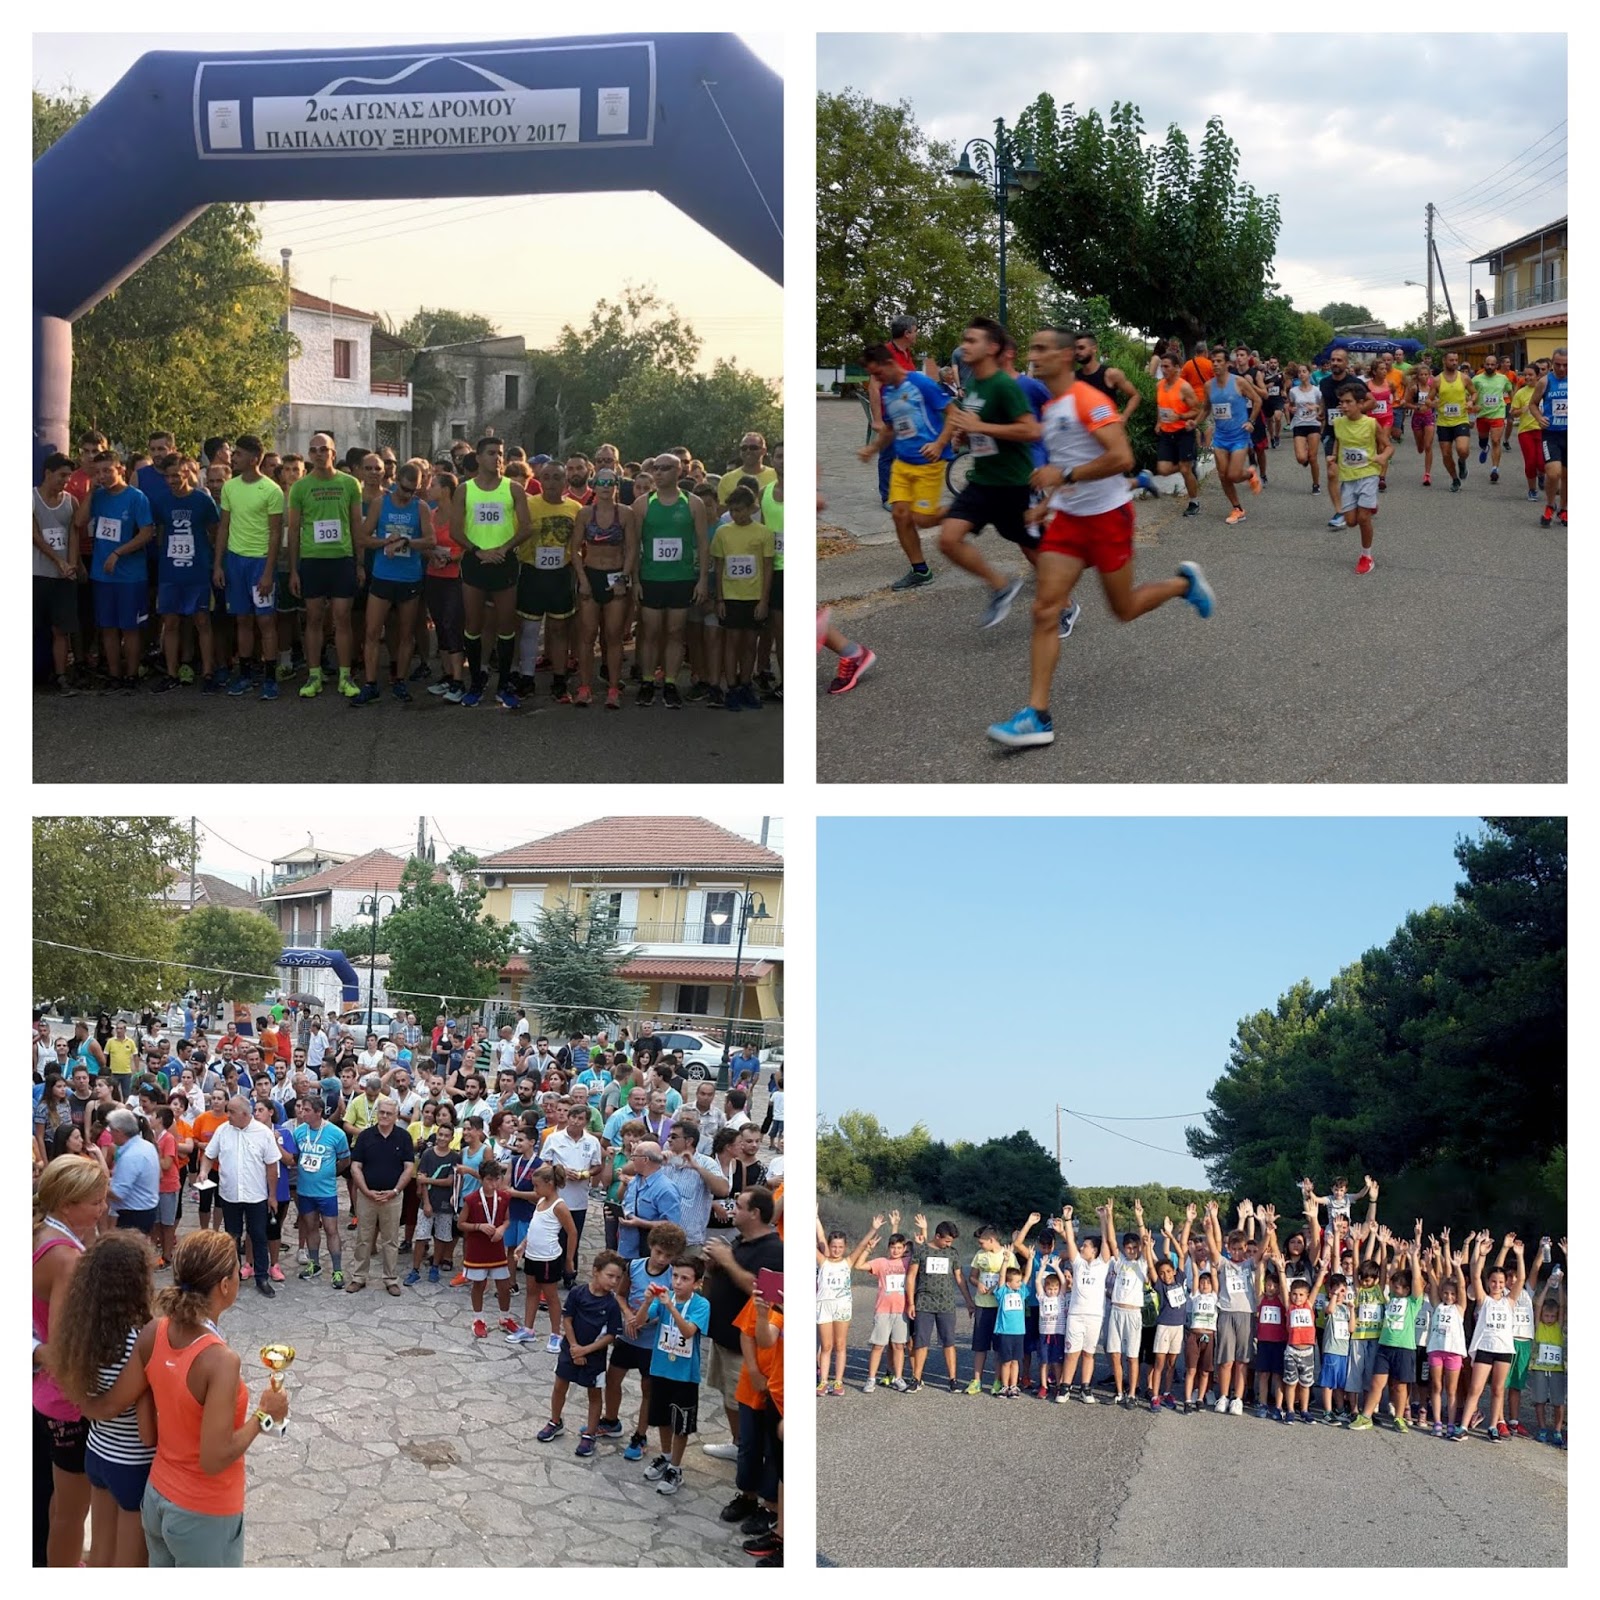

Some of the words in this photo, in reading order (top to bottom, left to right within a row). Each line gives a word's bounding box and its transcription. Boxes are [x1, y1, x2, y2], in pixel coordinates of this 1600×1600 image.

[305, 98, 338, 125] 2ος
[341, 98, 424, 122] ΑΓΩΝΑΣ
[428, 97, 517, 119] ΔΡΟΜΟΥ
[266, 129, 387, 148] ΠΑΠΑΔΑΤΟΥ
[392, 125, 521, 147] ΞΗΡΟΜΕΡΟΥ
[527, 123, 567, 144] 2017
[1345, 452, 1363, 461] 203
[479, 511, 500, 522] 306
[101, 525, 117, 538] 221
[319, 529, 338, 540] 303
[171, 544, 191, 554] 333
[658, 547, 679, 558] 307
[540, 556, 561, 567] 205
[731, 564, 753, 576] 236
[280, 956, 332, 967] OLYMPUS
[303, 1157, 318, 1167] 210
[827, 1277, 842, 1286] 141
[1362, 1311, 1378, 1320] 138
[664, 1331, 687, 1348] 13
[1543, 1351, 1560, 1361] 136
